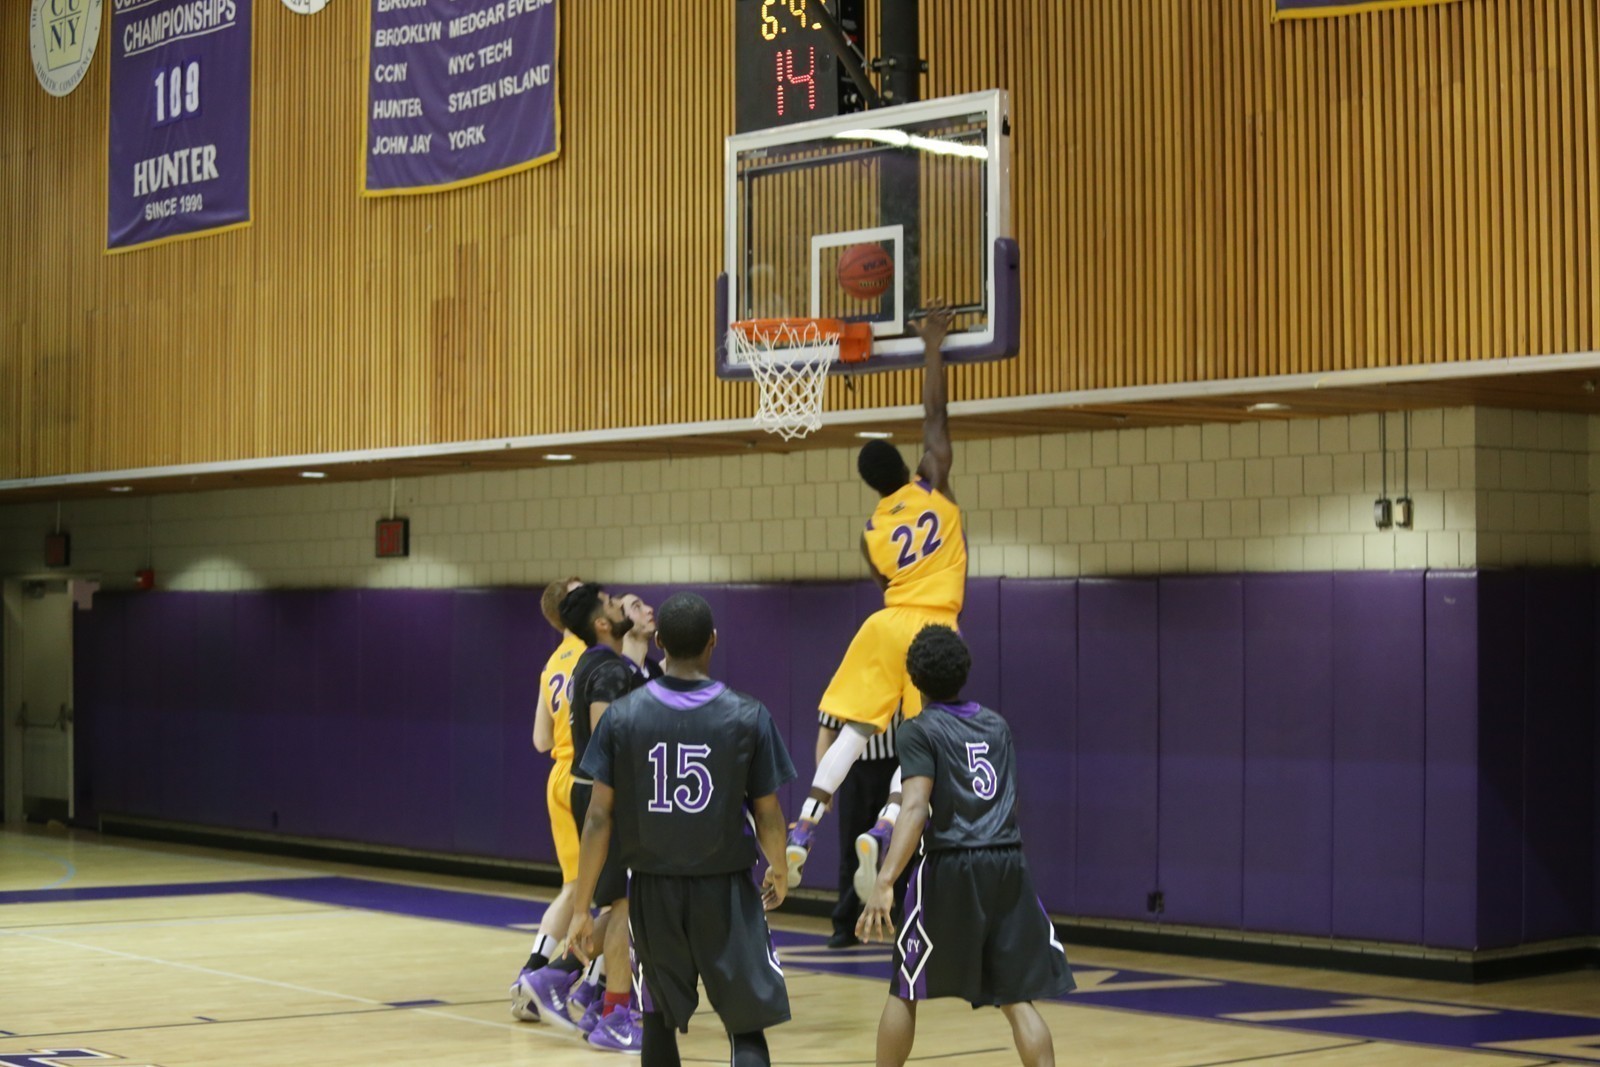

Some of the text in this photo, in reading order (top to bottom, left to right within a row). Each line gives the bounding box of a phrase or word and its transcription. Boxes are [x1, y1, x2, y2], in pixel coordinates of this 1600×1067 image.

[124, 0, 236, 52] CHAMPIONSHIPS
[375, 21, 442, 47] BROOKLYN
[449, 0, 553, 38] MEDGAR EVE
[375, 62, 408, 82] CCNY
[448, 38, 513, 75] NYC TECH
[155, 61, 199, 121] 109
[448, 64, 551, 113] STATEN ISLAND
[776, 46, 815, 116] 14
[373, 98, 423, 119] HUNTER
[372, 133, 433, 155] JOHN JAY
[448, 125, 486, 151] YORK
[133, 144, 219, 197] HUNTER
[145, 193, 203, 221] SINCE 1990
[890, 510, 942, 570] 22
[648, 742, 714, 813] 15
[965, 741, 997, 800] 5
